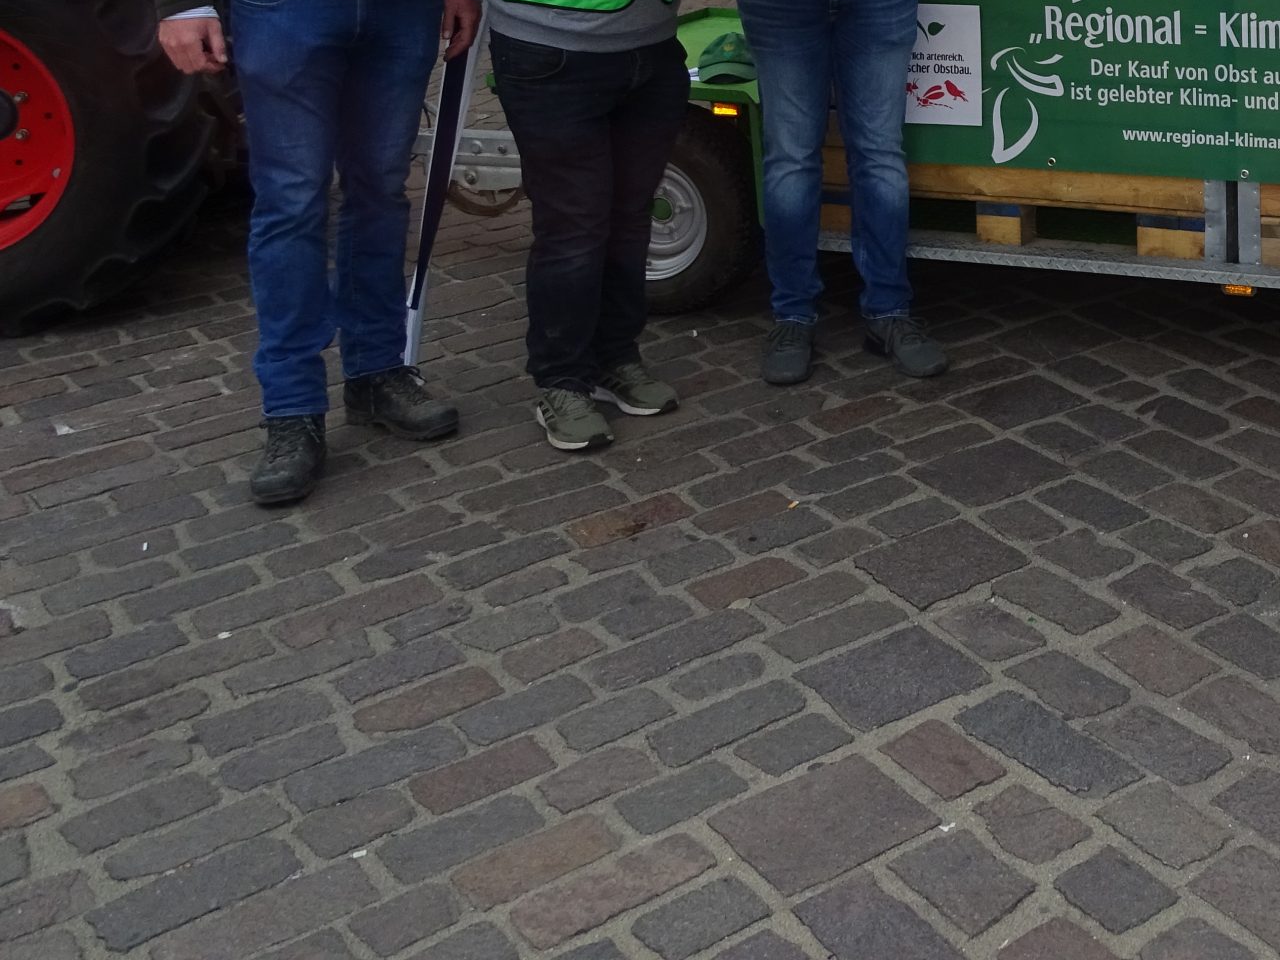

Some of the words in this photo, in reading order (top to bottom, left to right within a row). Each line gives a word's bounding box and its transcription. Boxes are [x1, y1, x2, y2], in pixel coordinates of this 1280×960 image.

[926, 52, 965, 62] artenreich.
[933, 63, 972, 75] Obstbau.
[1090, 58, 1122, 77] Der
[1128, 60, 1170, 80] Kauf
[1175, 66, 1208, 81] von
[1214, 64, 1258, 84] Obst
[1070, 82, 1092, 101] ist
[1097, 84, 1174, 106] gelebter
[1179, 87, 1239, 108] Klima-
[1244, 91, 1279, 111] und
